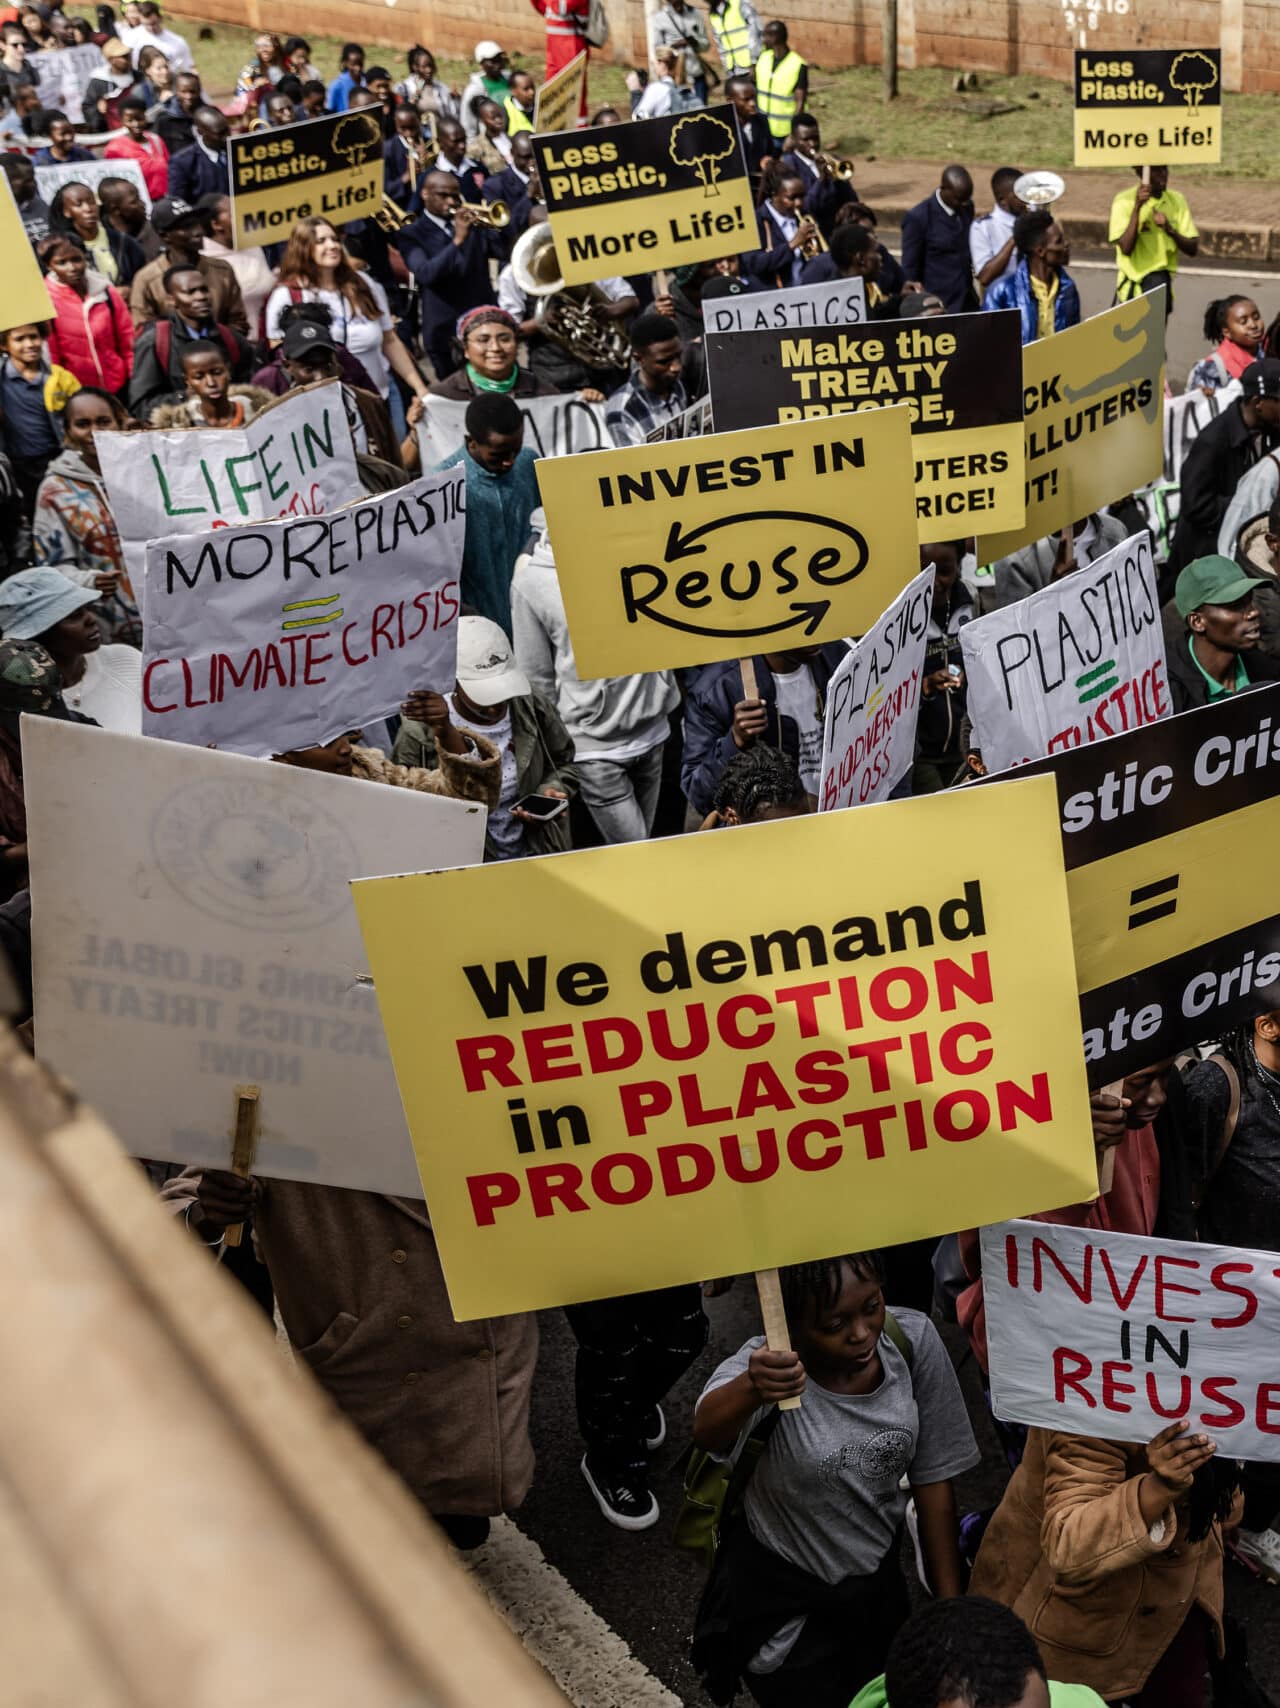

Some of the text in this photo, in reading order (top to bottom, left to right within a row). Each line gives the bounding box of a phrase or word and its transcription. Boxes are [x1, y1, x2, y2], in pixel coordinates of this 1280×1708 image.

[1080, 58, 1134, 78] Less
[1080, 80, 1165, 104] Plastic,
[237, 138, 295, 164] Less
[542, 141, 618, 171] Less
[1084, 126, 1213, 149] More Life!
[238, 154, 328, 187] Plastic,
[550, 162, 668, 201] Plastic,
[243, 181, 376, 233] More Life!
[567, 205, 746, 262] More Life!
[780, 328, 957, 369] Make the
[791, 360, 949, 400] TREATY
[1024, 378, 1153, 462] LLUTERS
[152, 434, 290, 517] LIFE
[291, 408, 335, 477] IN
[598, 437, 866, 508] INVEST IN
[143, 580, 461, 714] CLIMATE CRISIS
[996, 544, 1155, 711] PLASTICS
[829, 585, 932, 753] PLASTICS
[462, 879, 988, 1021] We demand
[454, 950, 995, 1095] REDUCTION
[508, 1021, 995, 1155] in PLASTIC
[465, 1071, 1055, 1228] PRODUCTION
[1120, 1319, 1189, 1369] IN
